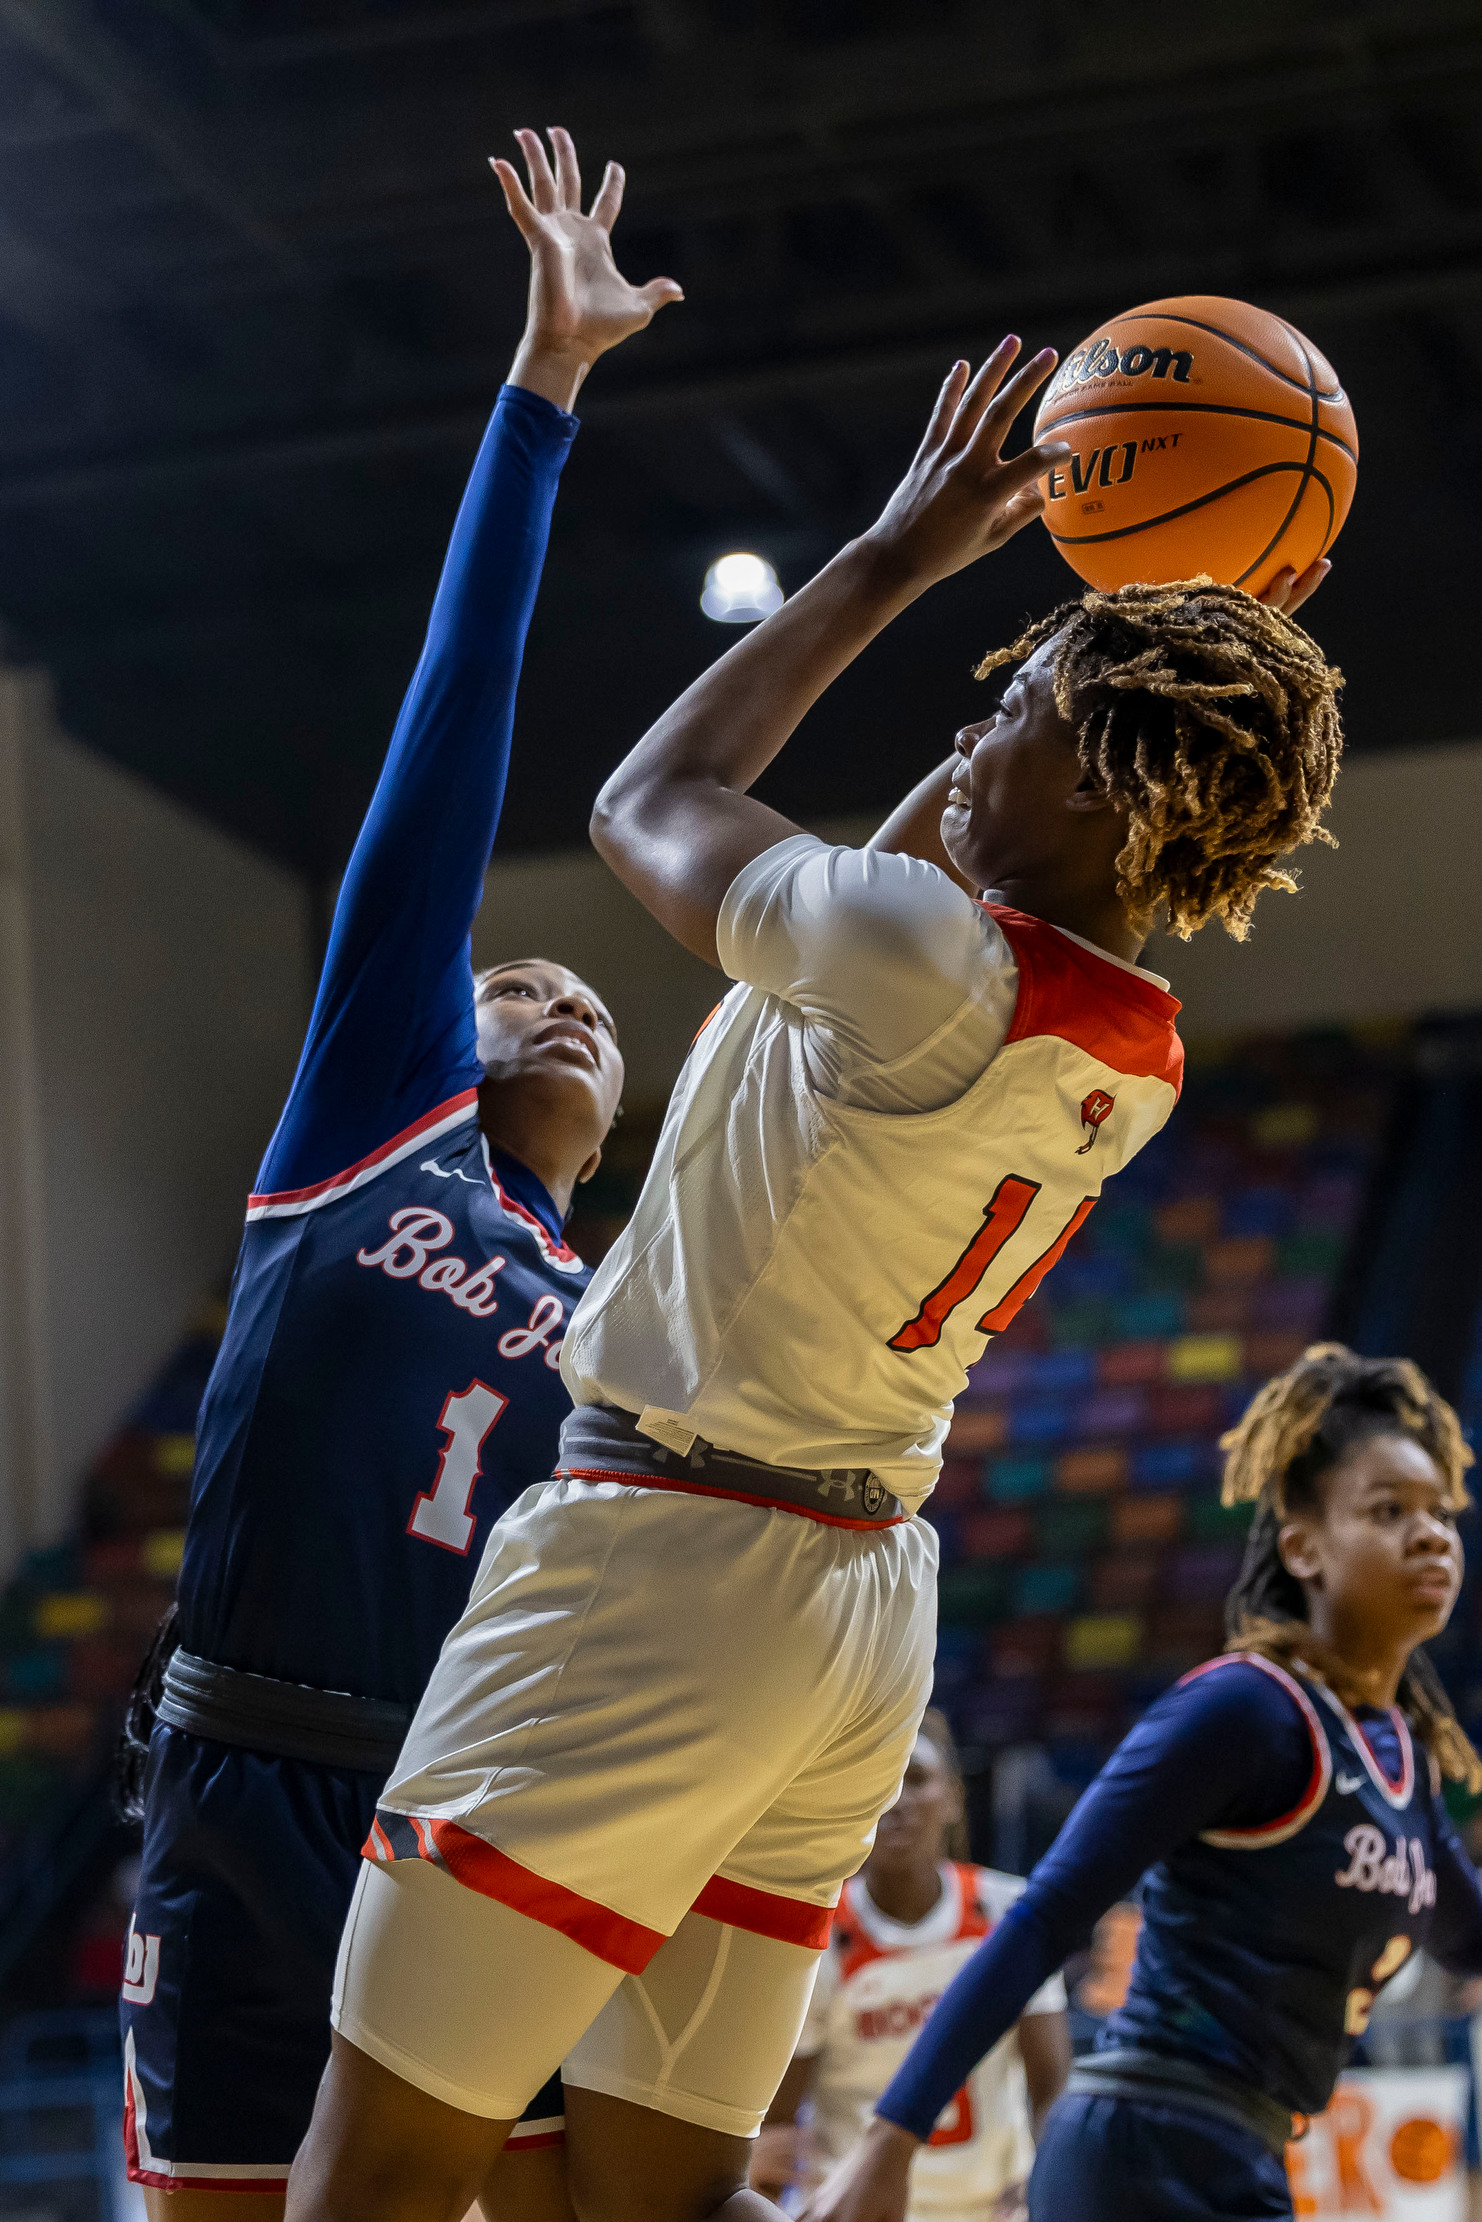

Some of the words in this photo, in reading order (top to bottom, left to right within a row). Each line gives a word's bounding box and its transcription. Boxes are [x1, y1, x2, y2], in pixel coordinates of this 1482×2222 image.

[1060, 337, 1194, 390] ilson
[1141, 432, 1183, 453] NXT
[1089, 1096, 1111, 1121] H
[356, 1206, 506, 1318] Bob
[406, 1377, 510, 1556] 1
